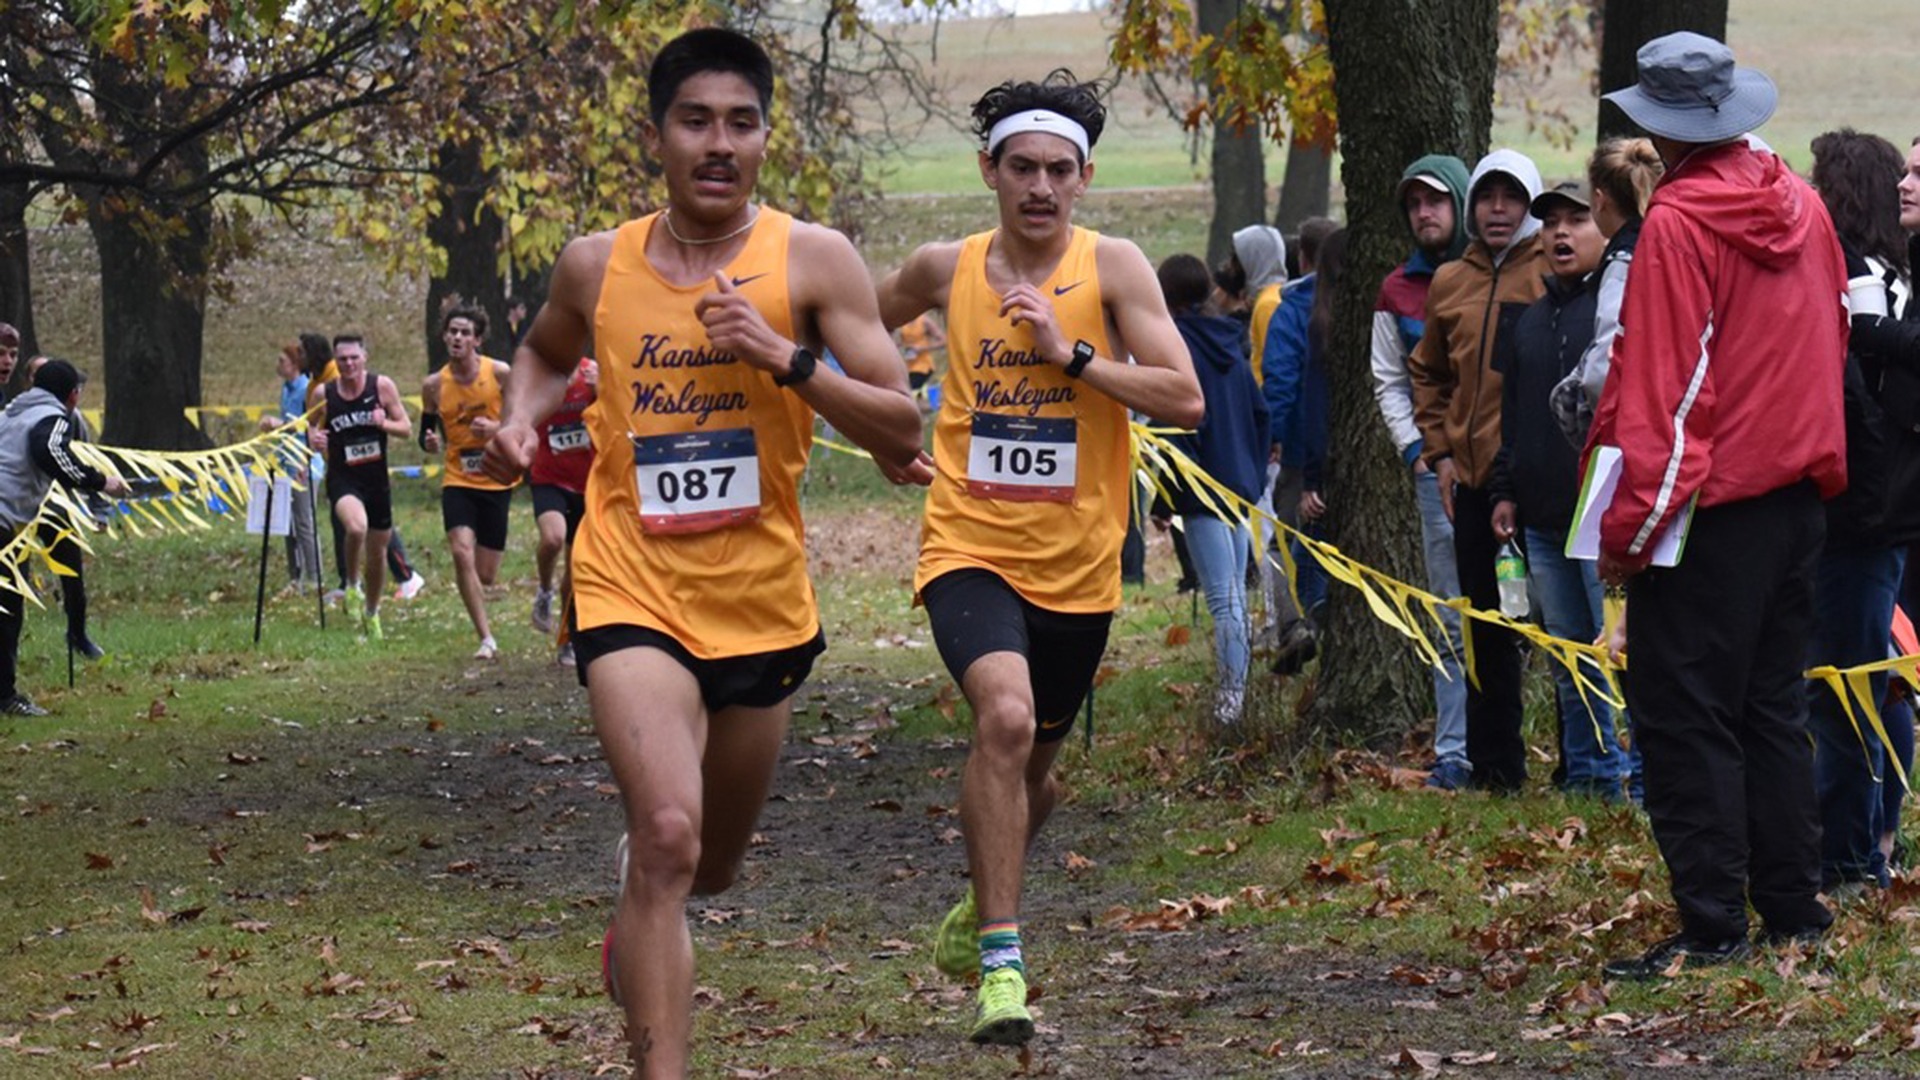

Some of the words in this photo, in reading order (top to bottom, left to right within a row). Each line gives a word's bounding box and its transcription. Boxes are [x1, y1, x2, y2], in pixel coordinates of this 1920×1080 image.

[973, 338, 1048, 369] Kans
[631, 379, 749, 426] Wesleyan
[973, 376, 1077, 416] Wesleyan
[557, 432, 582, 446] 117
[988, 445, 1058, 476] 105
[657, 466, 737, 503] 087
